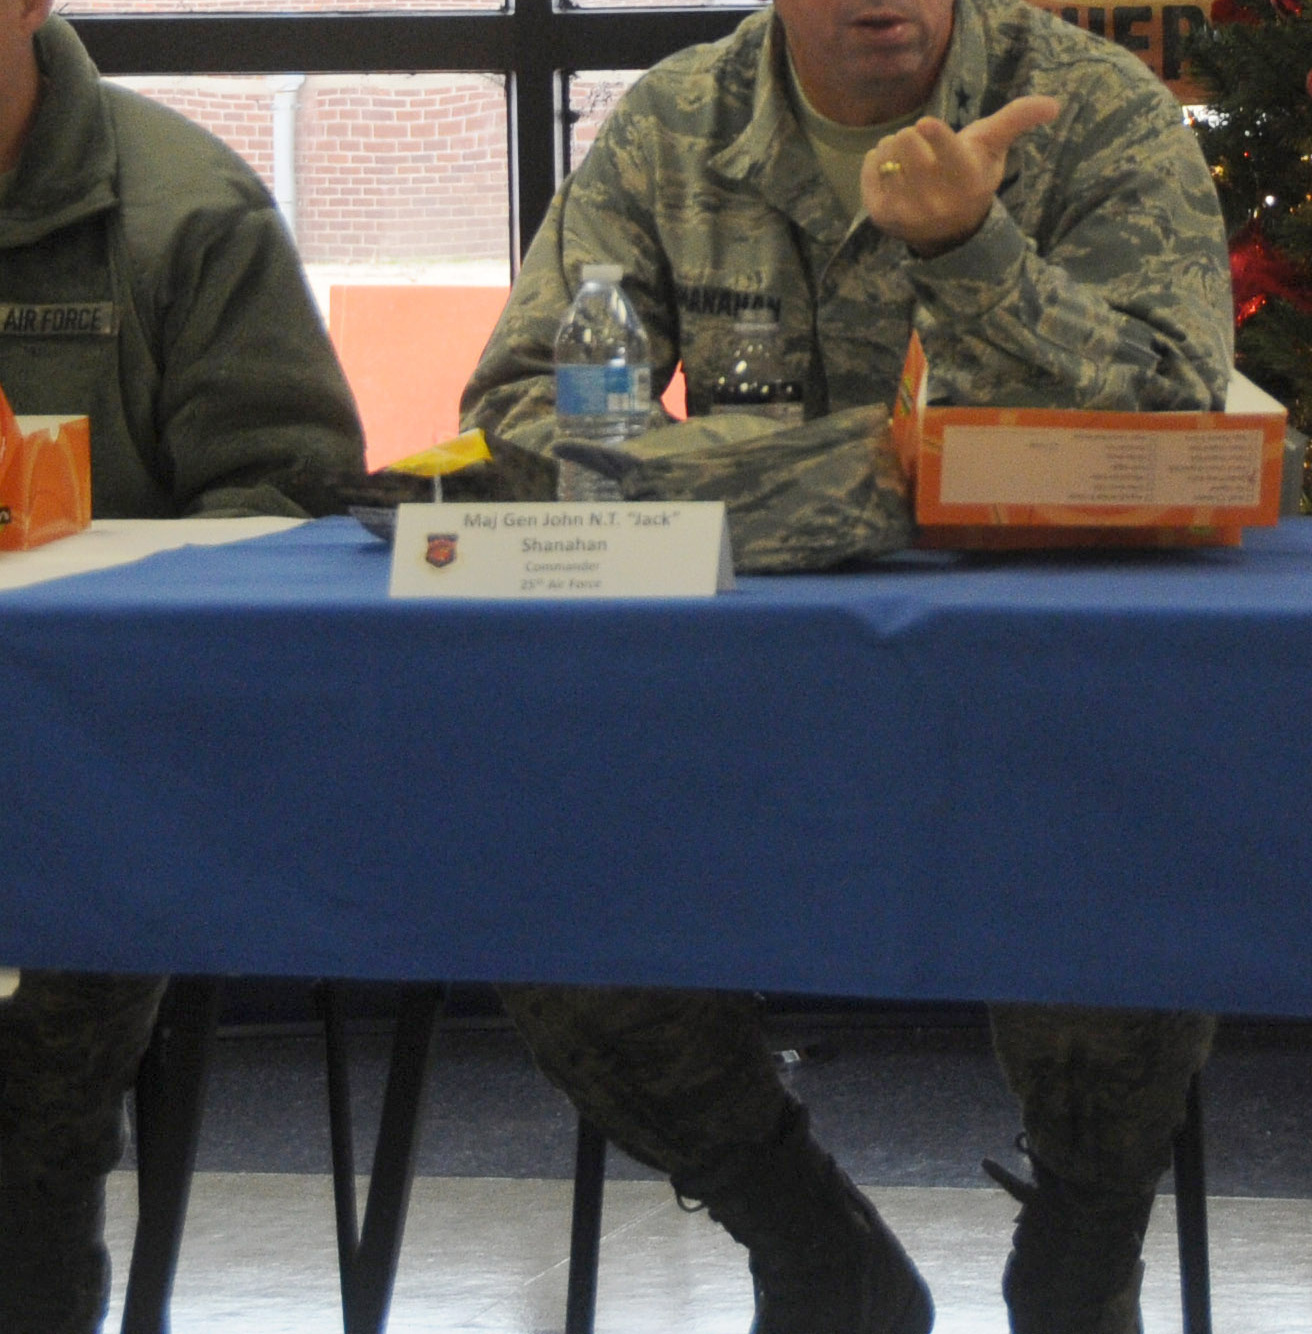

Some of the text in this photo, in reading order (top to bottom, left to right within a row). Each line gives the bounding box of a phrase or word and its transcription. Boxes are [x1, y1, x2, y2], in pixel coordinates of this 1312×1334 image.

[4, 308, 36, 332] AIR
[40, 306, 102, 332] FORCE
[464, 512, 497, 531] Maj
[504, 512, 538, 527] Gen
[542, 511, 584, 527] John
[590, 512, 620, 527] N.T.
[521, 537, 608, 554] Shanahan
[525, 561, 600, 573] Commander
[548, 577, 566, 591] Air
[569, 577, 602, 591] Force
